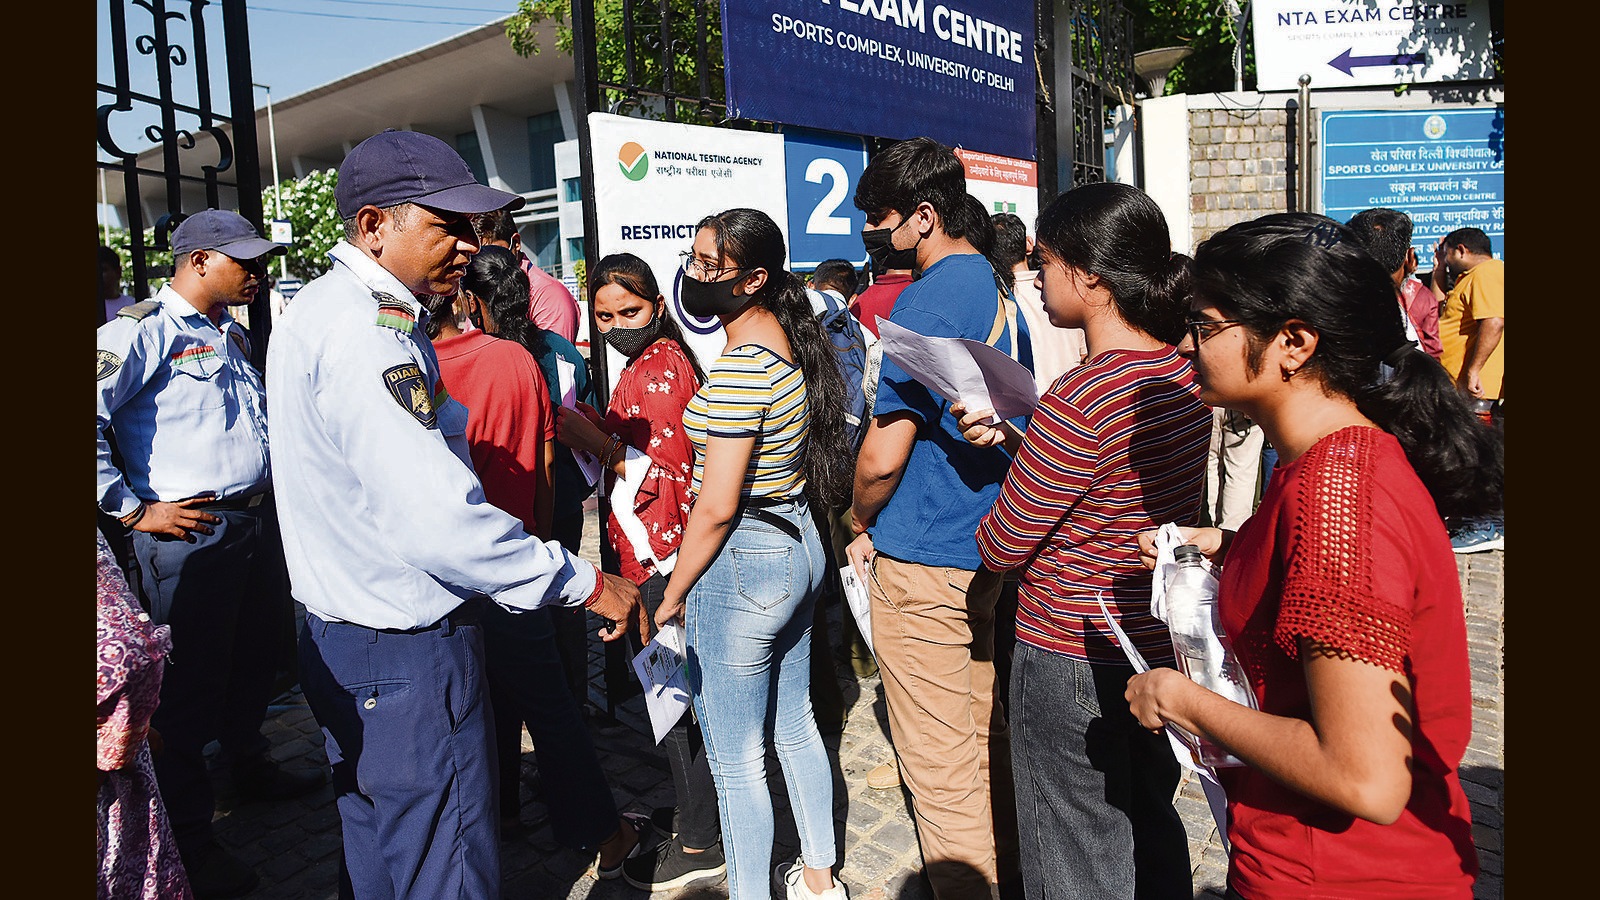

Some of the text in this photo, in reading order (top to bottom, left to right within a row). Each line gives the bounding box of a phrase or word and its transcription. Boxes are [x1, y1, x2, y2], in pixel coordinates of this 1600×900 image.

[1278, 4, 1468, 26] NTA EXAM CENTRE
[840, 0, 1022, 63] XAM CENTRE
[1434, 26, 1460, 35] DELHI
[772, 13, 1014, 92] SPORTS COMPLEX, UNIVERSITY OF DELHI
[654, 151, 762, 166] NATIONAL TESTING AGENCY
[1370, 149, 1388, 161] खेल
[1390, 147, 1416, 161] परिसर
[1418, 147, 1443, 160] दिल्ली
[1328, 165, 1371, 175] SPORTS
[1374, 163, 1425, 173] COMPLEX
[1427, 161, 1489, 171] UNIVERSITY
[1389, 180, 1415, 195] संकुल
[804, 158, 851, 235] 2
[1369, 192, 1497, 204] CLUSTER INNOVATION CENTRE
[621, 224, 698, 240] RESTRICT
[1432, 223, 1491, 233] COMNITY
[389, 367, 420, 382] DIAM
